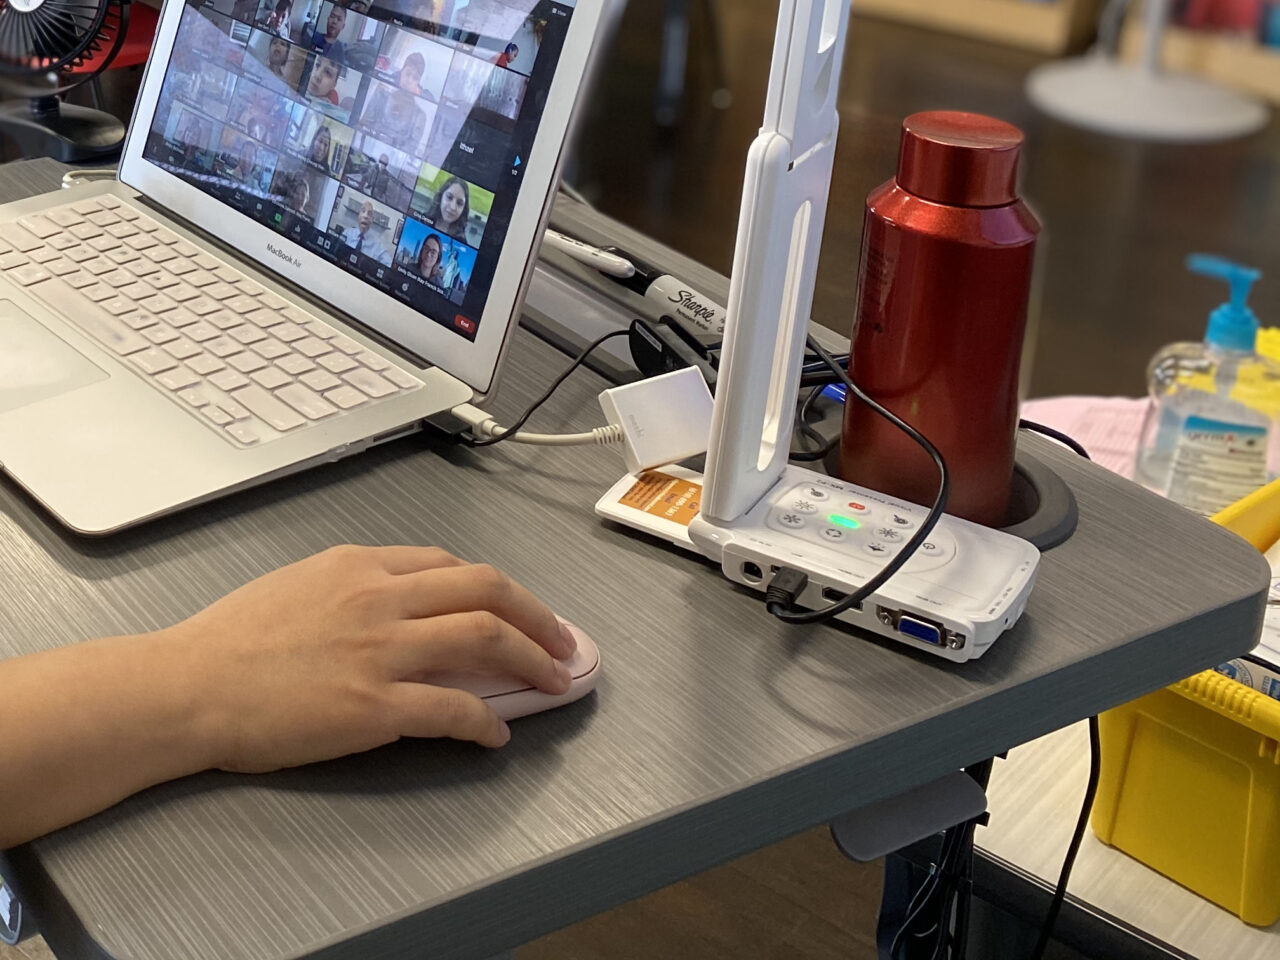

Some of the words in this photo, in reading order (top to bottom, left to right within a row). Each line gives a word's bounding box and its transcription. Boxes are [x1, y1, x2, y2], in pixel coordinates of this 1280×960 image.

[266, 243, 293, 263] MacBook
[293, 259, 302, 268] Air
[668, 290, 715, 322] Sharpie
